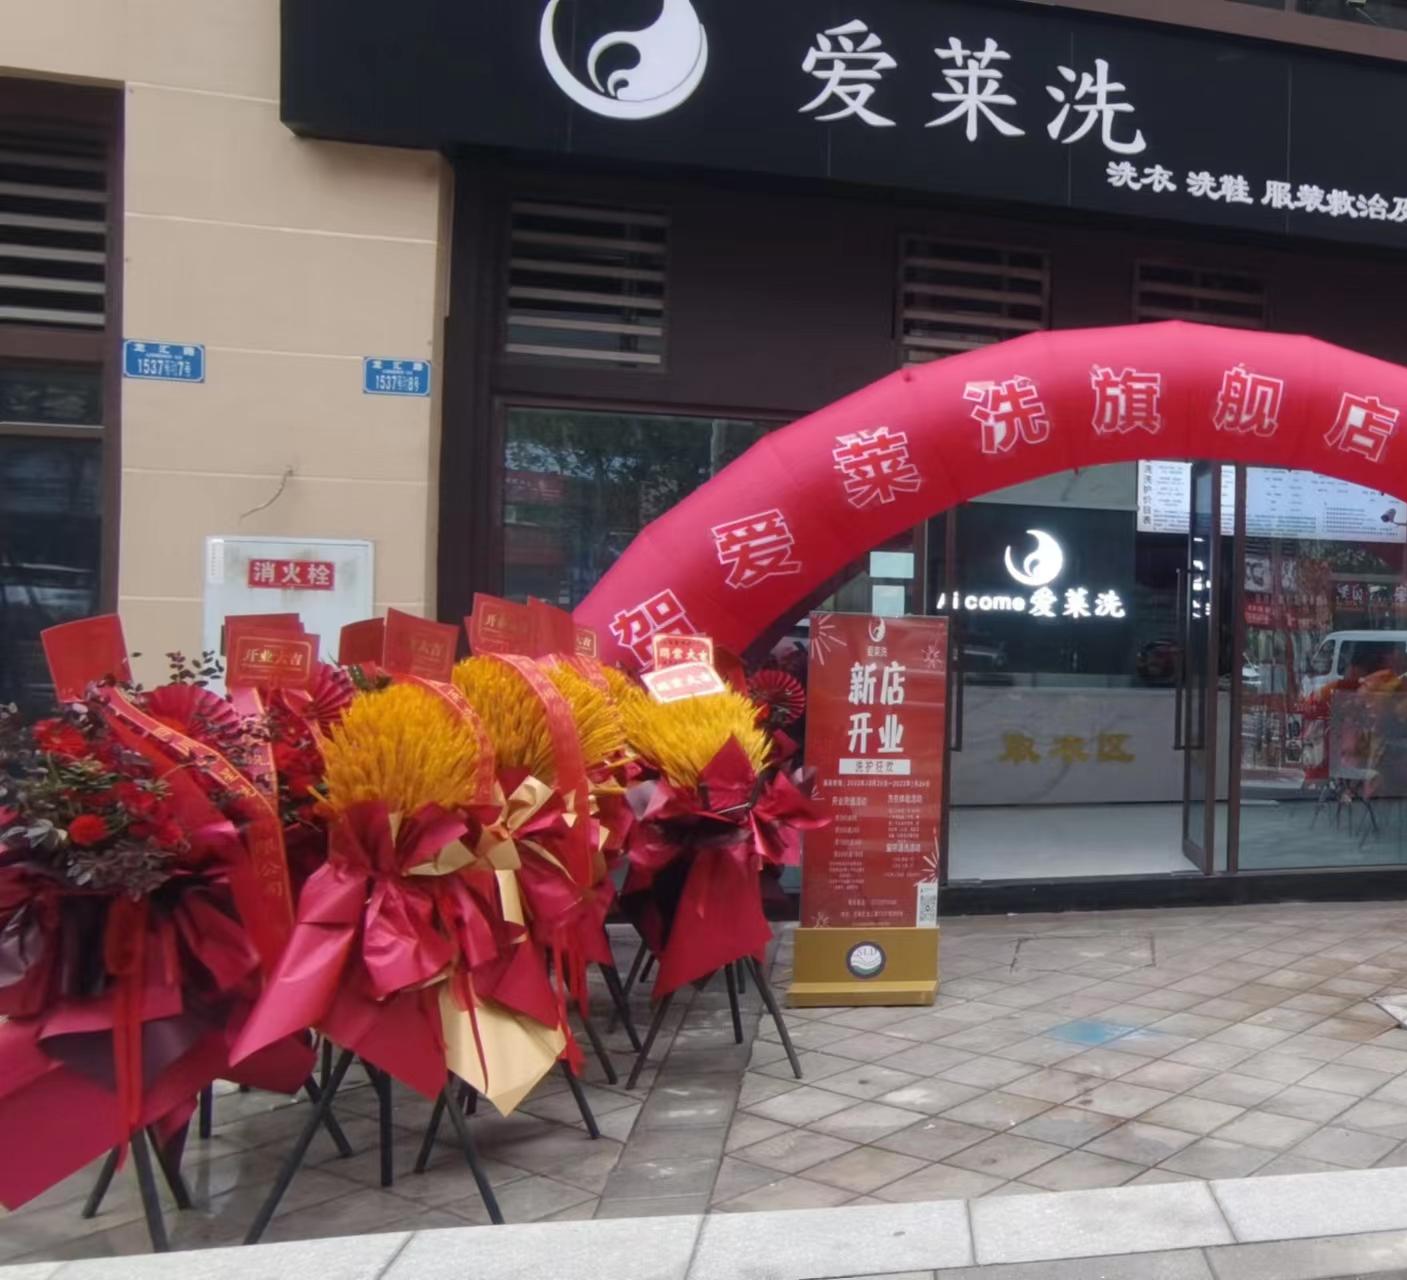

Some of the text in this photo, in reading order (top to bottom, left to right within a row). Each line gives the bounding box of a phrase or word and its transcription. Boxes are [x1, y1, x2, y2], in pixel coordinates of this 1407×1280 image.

[798, 19, 1147, 155] 爱莱洗
[1106, 161, 1176, 192] 洗衣
[1186, 170, 1254, 204] 洗鞋
[253, 562, 330, 585] 消火栓
[1028, 586, 1127, 619] 爱莱洗
[243, 648, 303, 667] 开业大吉
[848, 660, 907, 705] 新店
[847, 711, 905, 754] 开业
